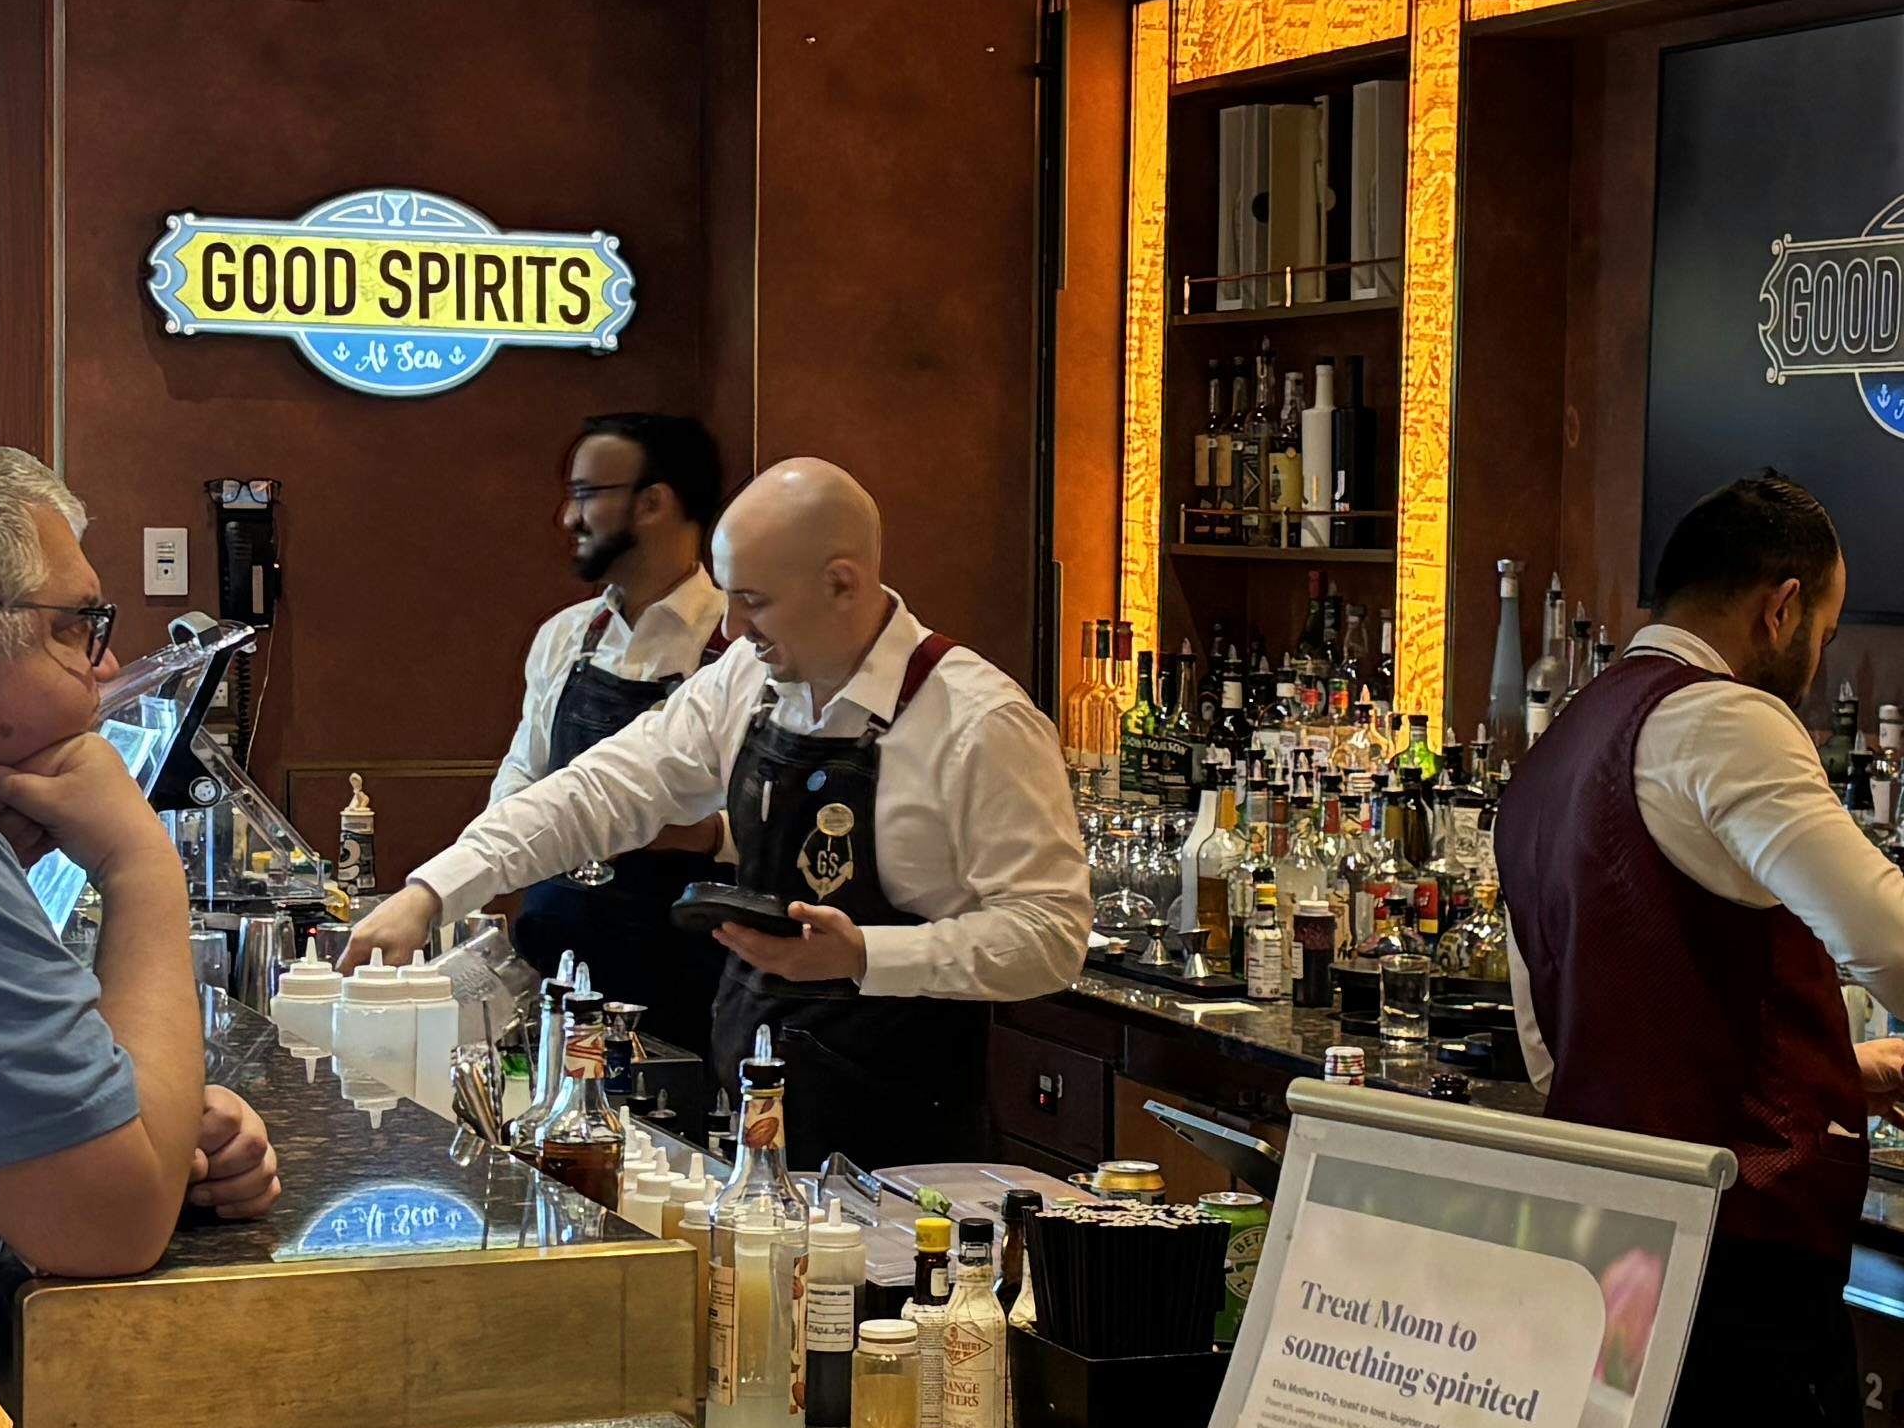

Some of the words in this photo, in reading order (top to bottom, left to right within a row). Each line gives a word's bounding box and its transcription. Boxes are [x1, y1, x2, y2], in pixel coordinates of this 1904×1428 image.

[201, 241, 357, 317] GOOD
[378, 248, 593, 326] SPIRITS
[1782, 255, 1902, 357] GOOD
[354, 339, 389, 375] At
[394, 340, 443, 374] Sea
[817, 850, 839, 878] GS
[1300, 1280, 1373, 1326] Treat
[1373, 1299, 1444, 1345] Mom
[1448, 1320, 1478, 1352] to
[1282, 1333, 1424, 1398] something
[1423, 1371, 1540, 1422] spirited
[1288, 1383, 1321, 1401] Mother's
[1369, 1405, 1389, 1421] love,
[1389, 1410, 1423, 1428] laughter
